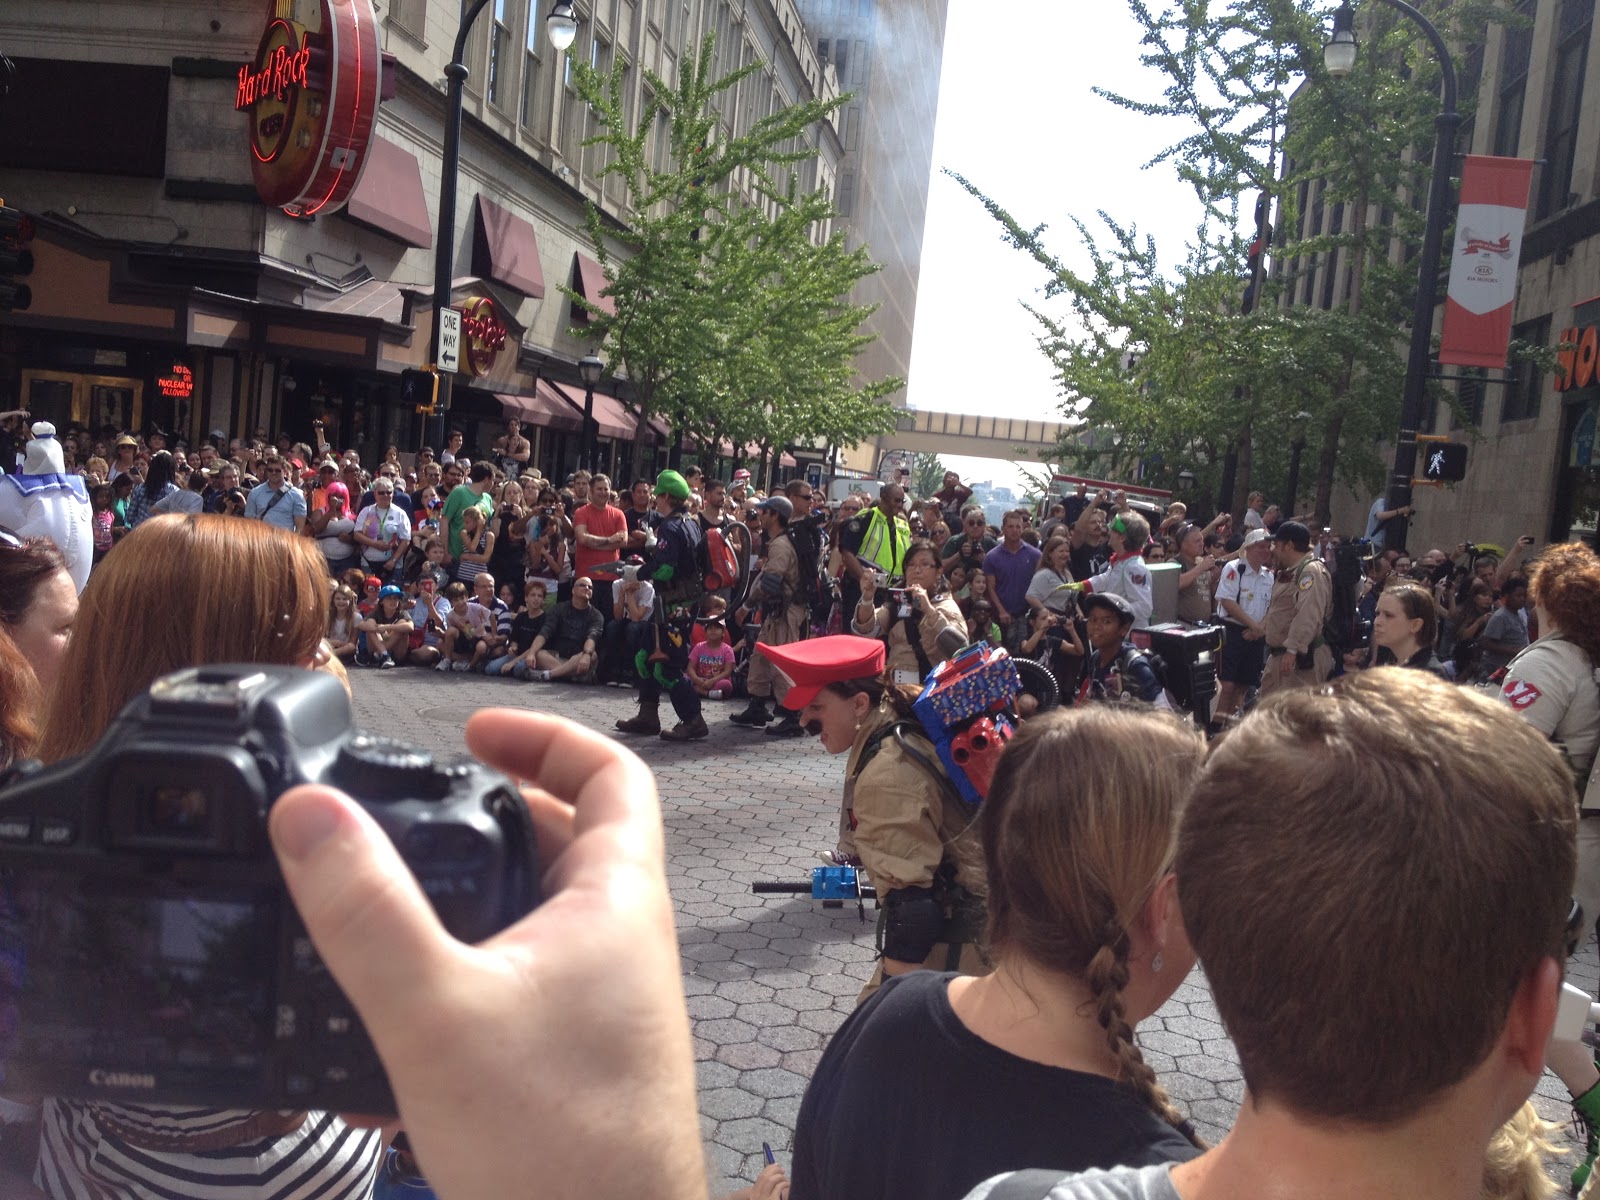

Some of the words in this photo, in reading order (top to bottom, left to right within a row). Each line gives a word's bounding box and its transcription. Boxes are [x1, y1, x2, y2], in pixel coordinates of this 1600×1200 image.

[236, 52, 274, 110] Hard
[273, 33, 310, 101] Rock
[443, 314, 457, 331] ONE
[442, 333, 457, 349] WAY
[1554, 325, 1600, 391] HO
[173, 365, 182, 374] NO
[158, 378, 185, 389] NUCLEAR
[162, 388, 190, 397] ALLOWED
[848, 483, 863, 492] US
[88, 1068, 156, 1089] Canon
